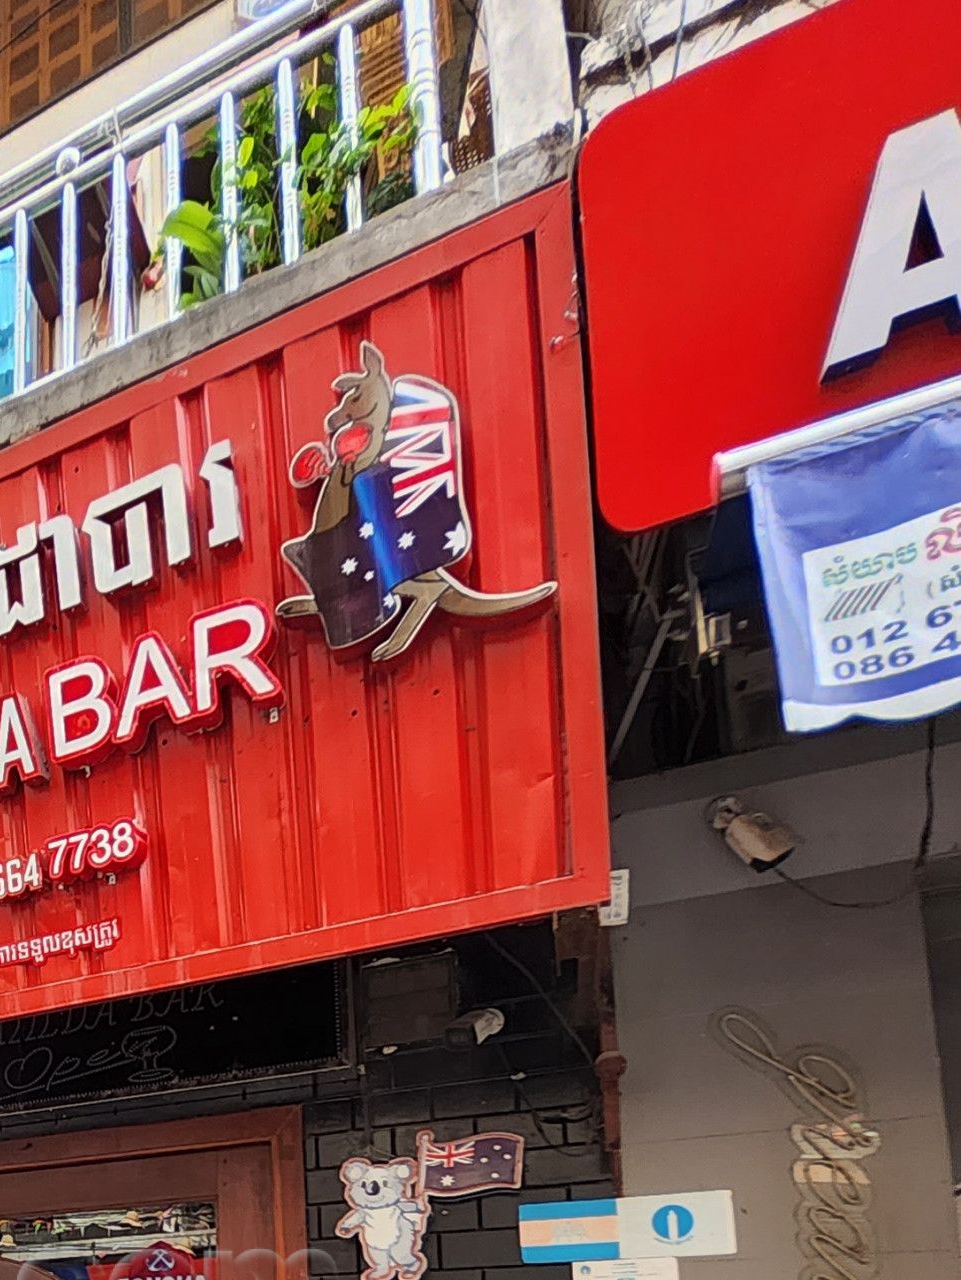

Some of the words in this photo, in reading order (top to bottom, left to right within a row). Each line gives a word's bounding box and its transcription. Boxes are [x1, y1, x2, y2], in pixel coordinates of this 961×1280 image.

[830, 620, 909, 654] 012
[926, 600, 961, 629] 6
[47, 607, 278, 758] BAR
[833, 645, 916, 680] 086
[47, 822, 135, 877] 7738
